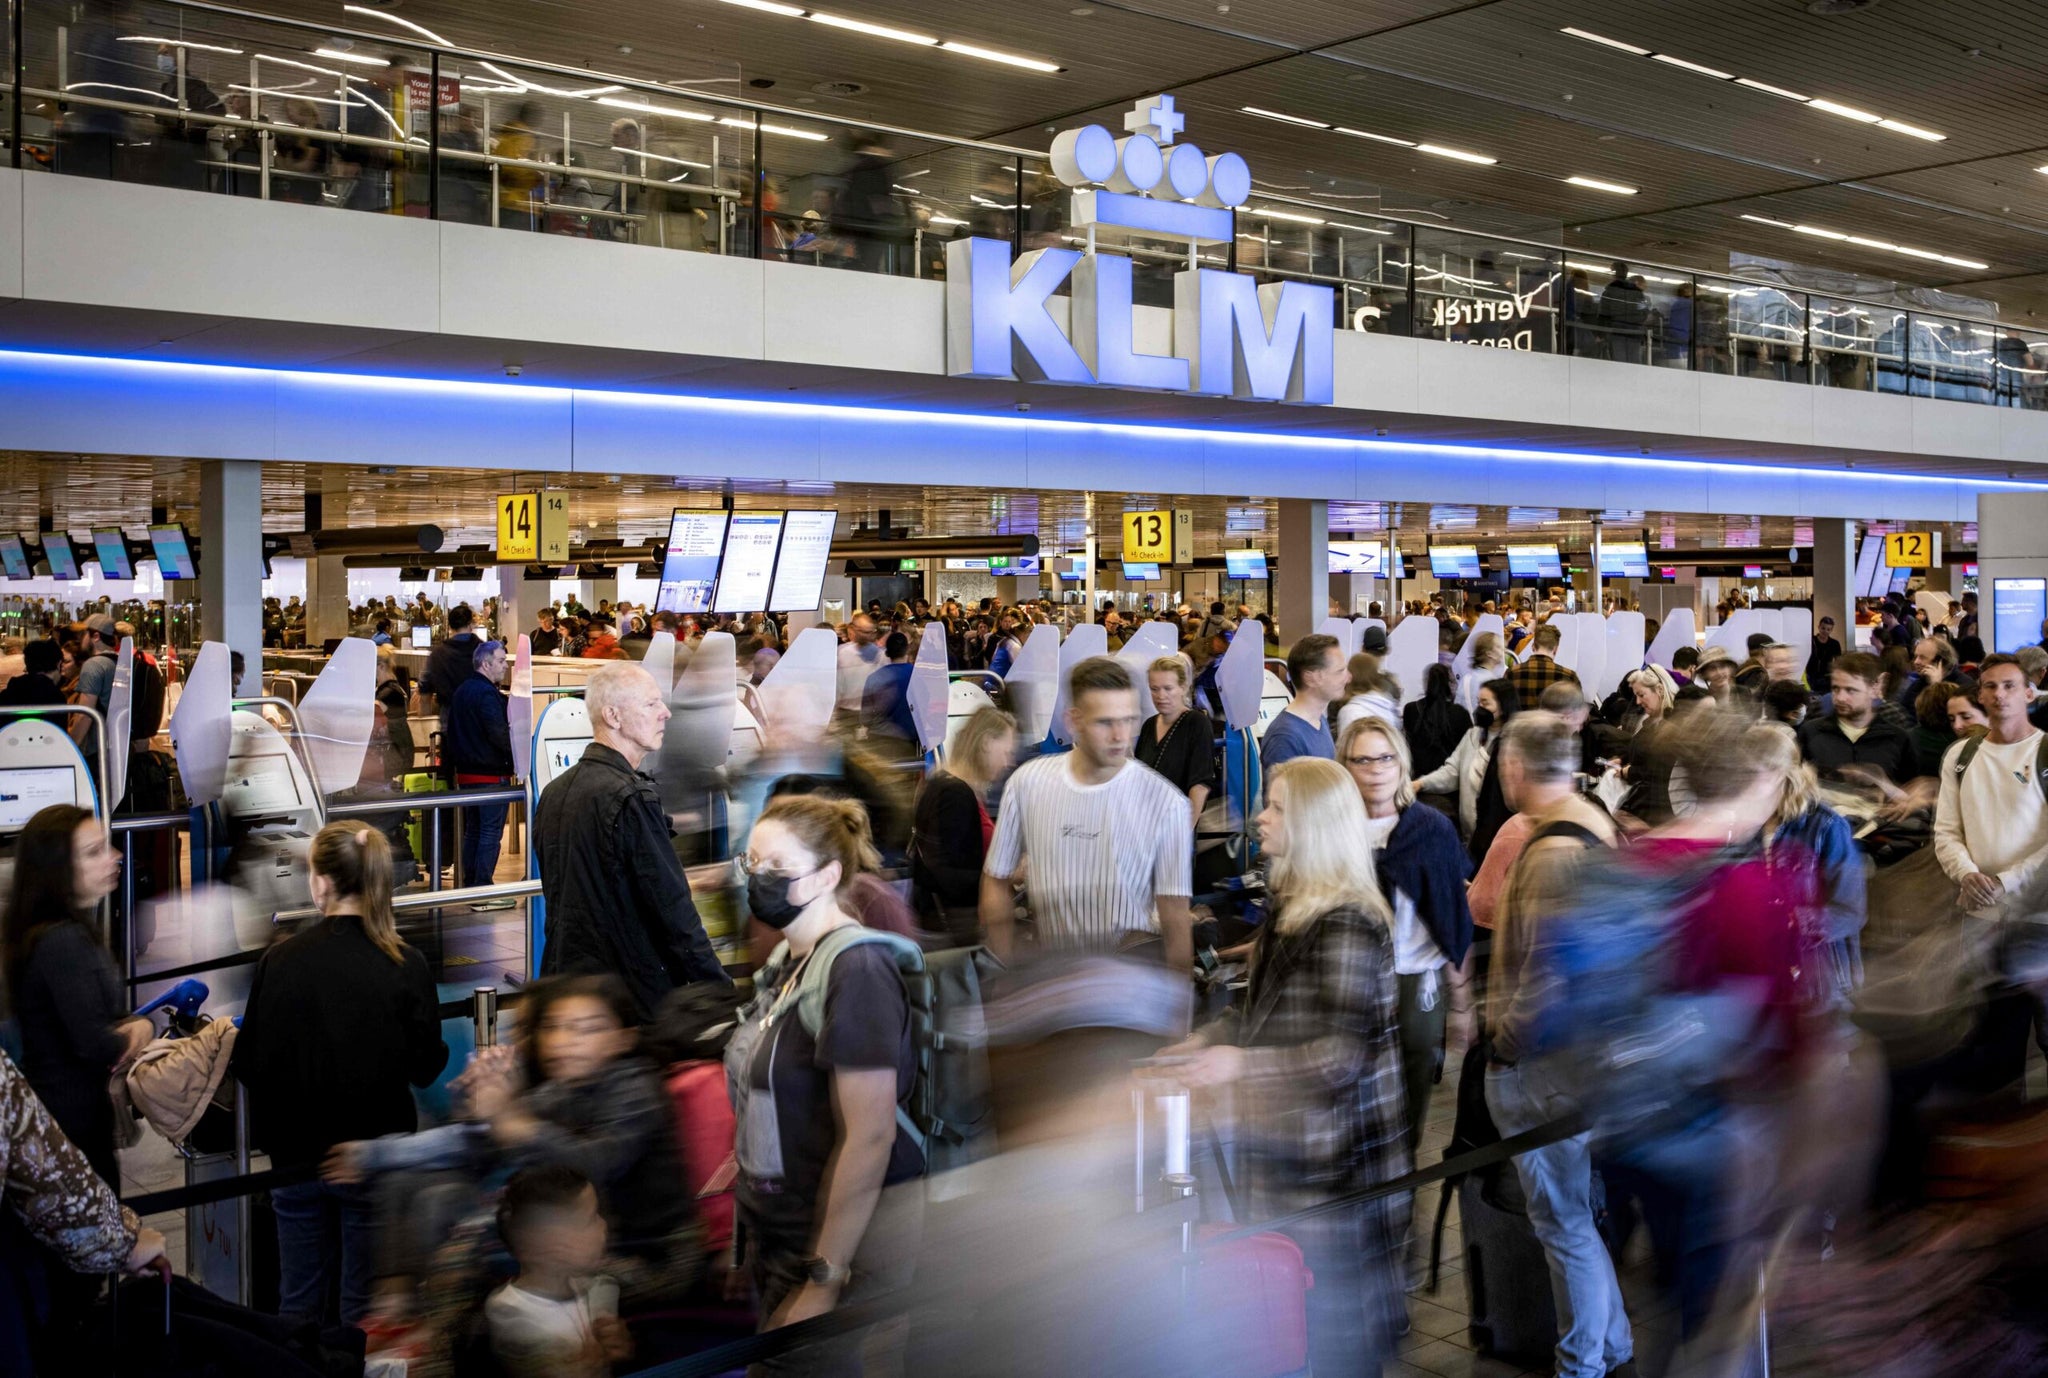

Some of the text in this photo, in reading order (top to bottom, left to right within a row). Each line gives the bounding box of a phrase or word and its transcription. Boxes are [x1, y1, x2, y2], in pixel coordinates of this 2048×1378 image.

[411, 80, 429, 88] Your
[411, 88, 417, 96] is
[441, 93, 453, 101] for
[948, 236, 1334, 406] KLM
[548, 498, 562, 510] 14
[505, 499, 531, 539] 14
[1179, 514, 1189, 524] 13
[1132, 515, 1162, 547] 13
[1894, 535, 1922, 556] 12
